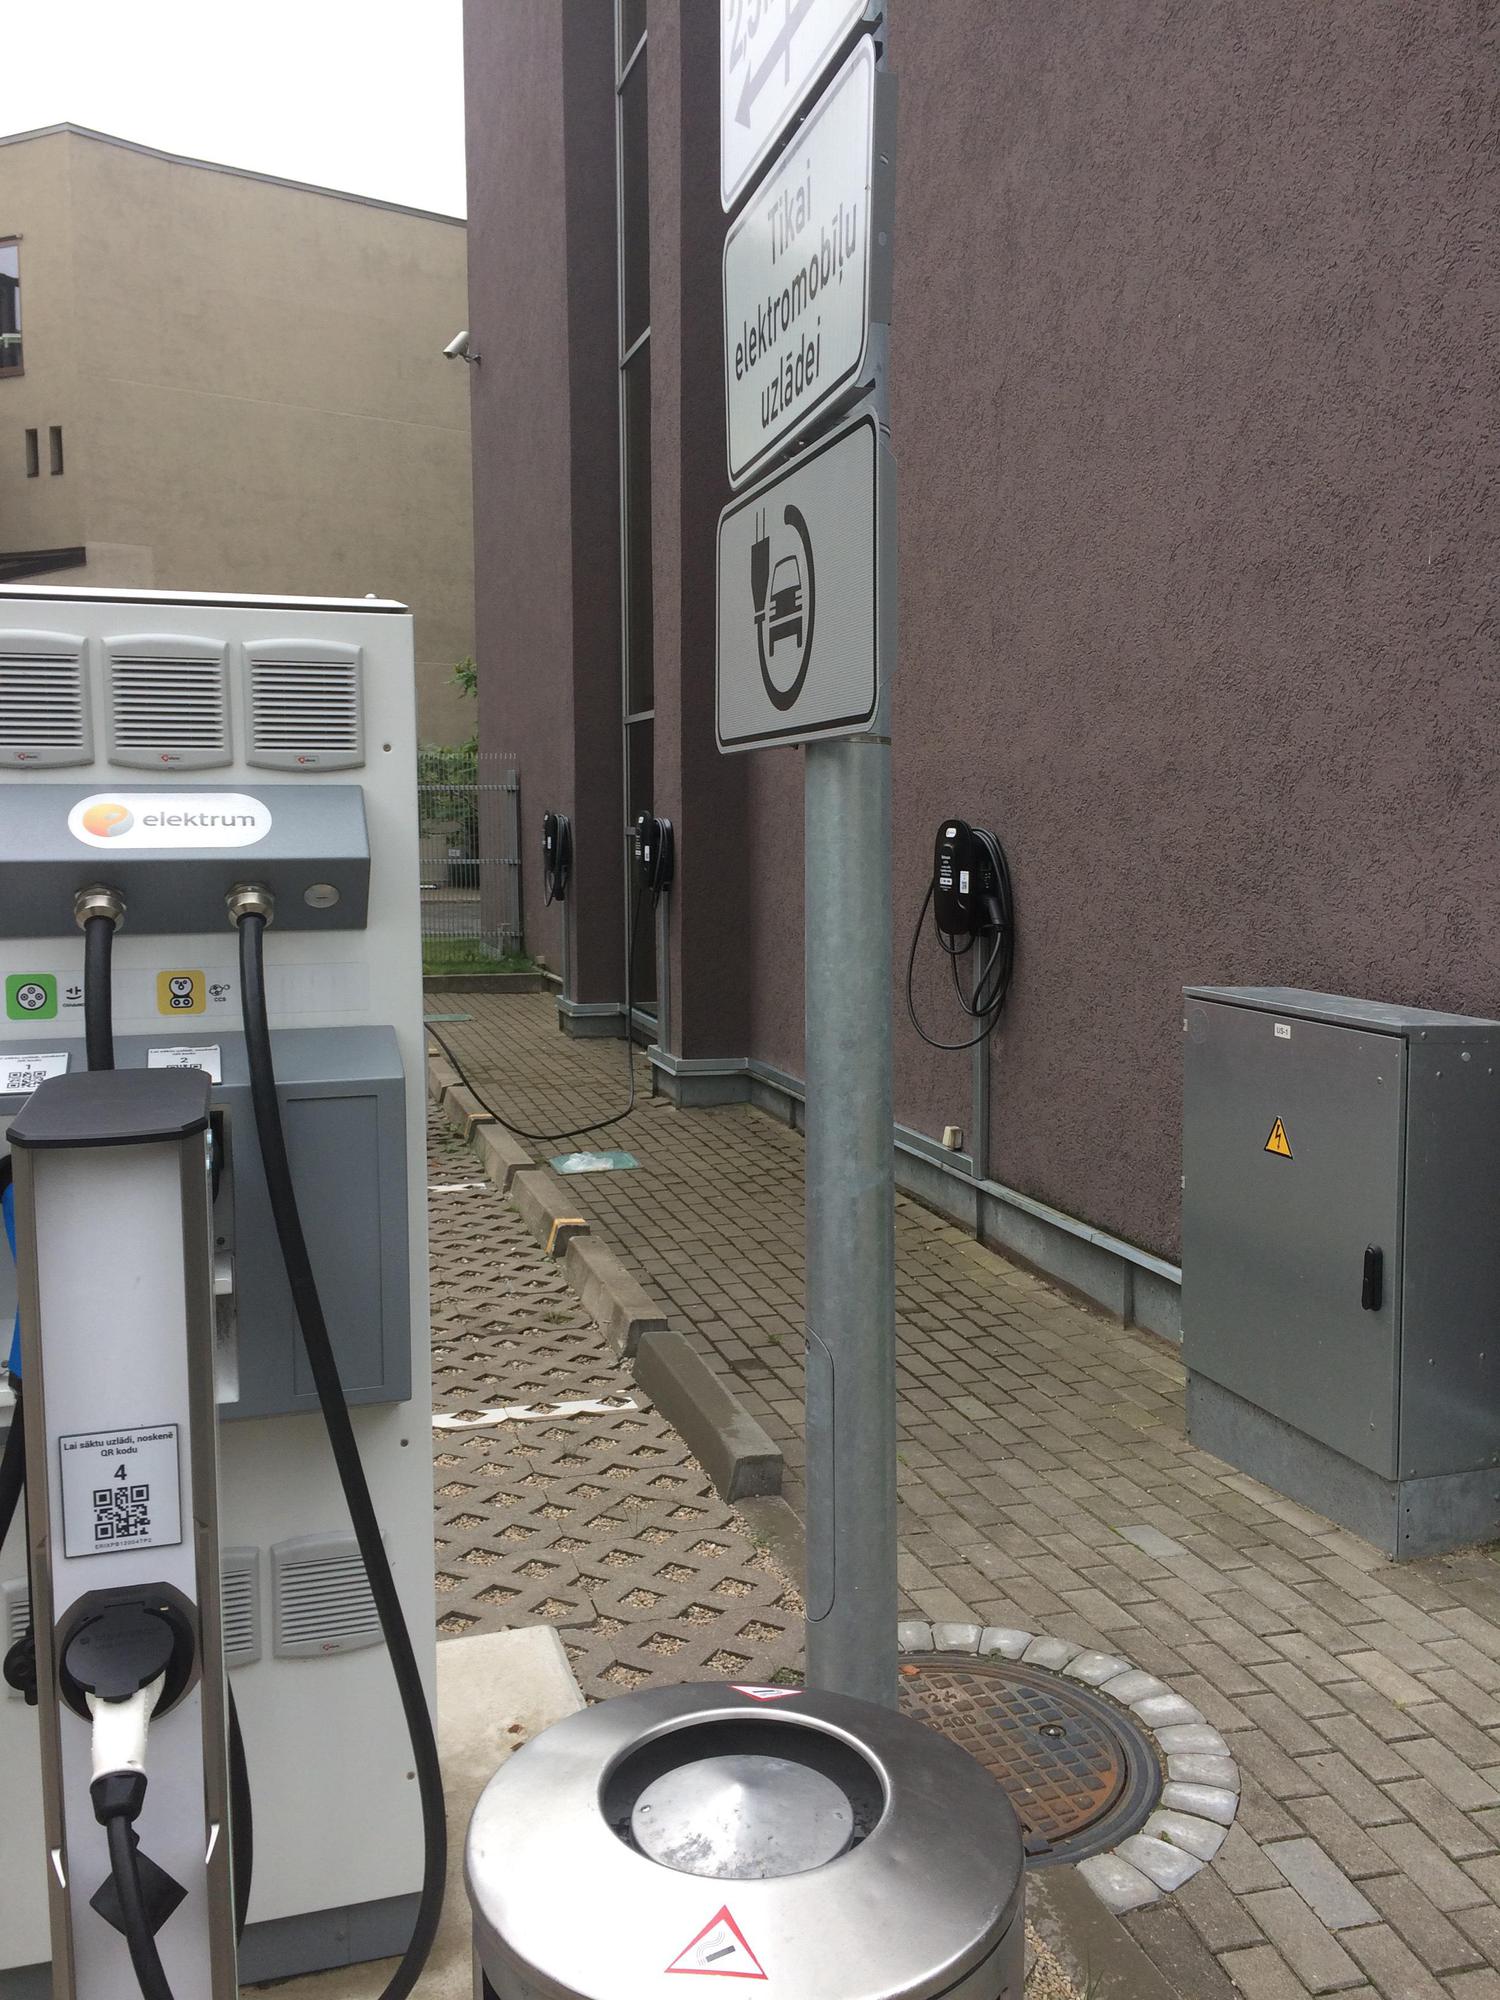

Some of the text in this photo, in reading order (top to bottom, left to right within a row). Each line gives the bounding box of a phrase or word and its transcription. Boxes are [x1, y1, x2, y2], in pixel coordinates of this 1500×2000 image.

[767, 158, 811, 265] Tikai
[761, 315, 821, 429] uzlādei
[142, 811, 255, 827] elektrum
[63, 1431, 174, 1451] Lai sāktu uzlādi, noskenē
[100, 1446, 138, 1457] QR kodu
[114, 1464, 127, 1480] 4
